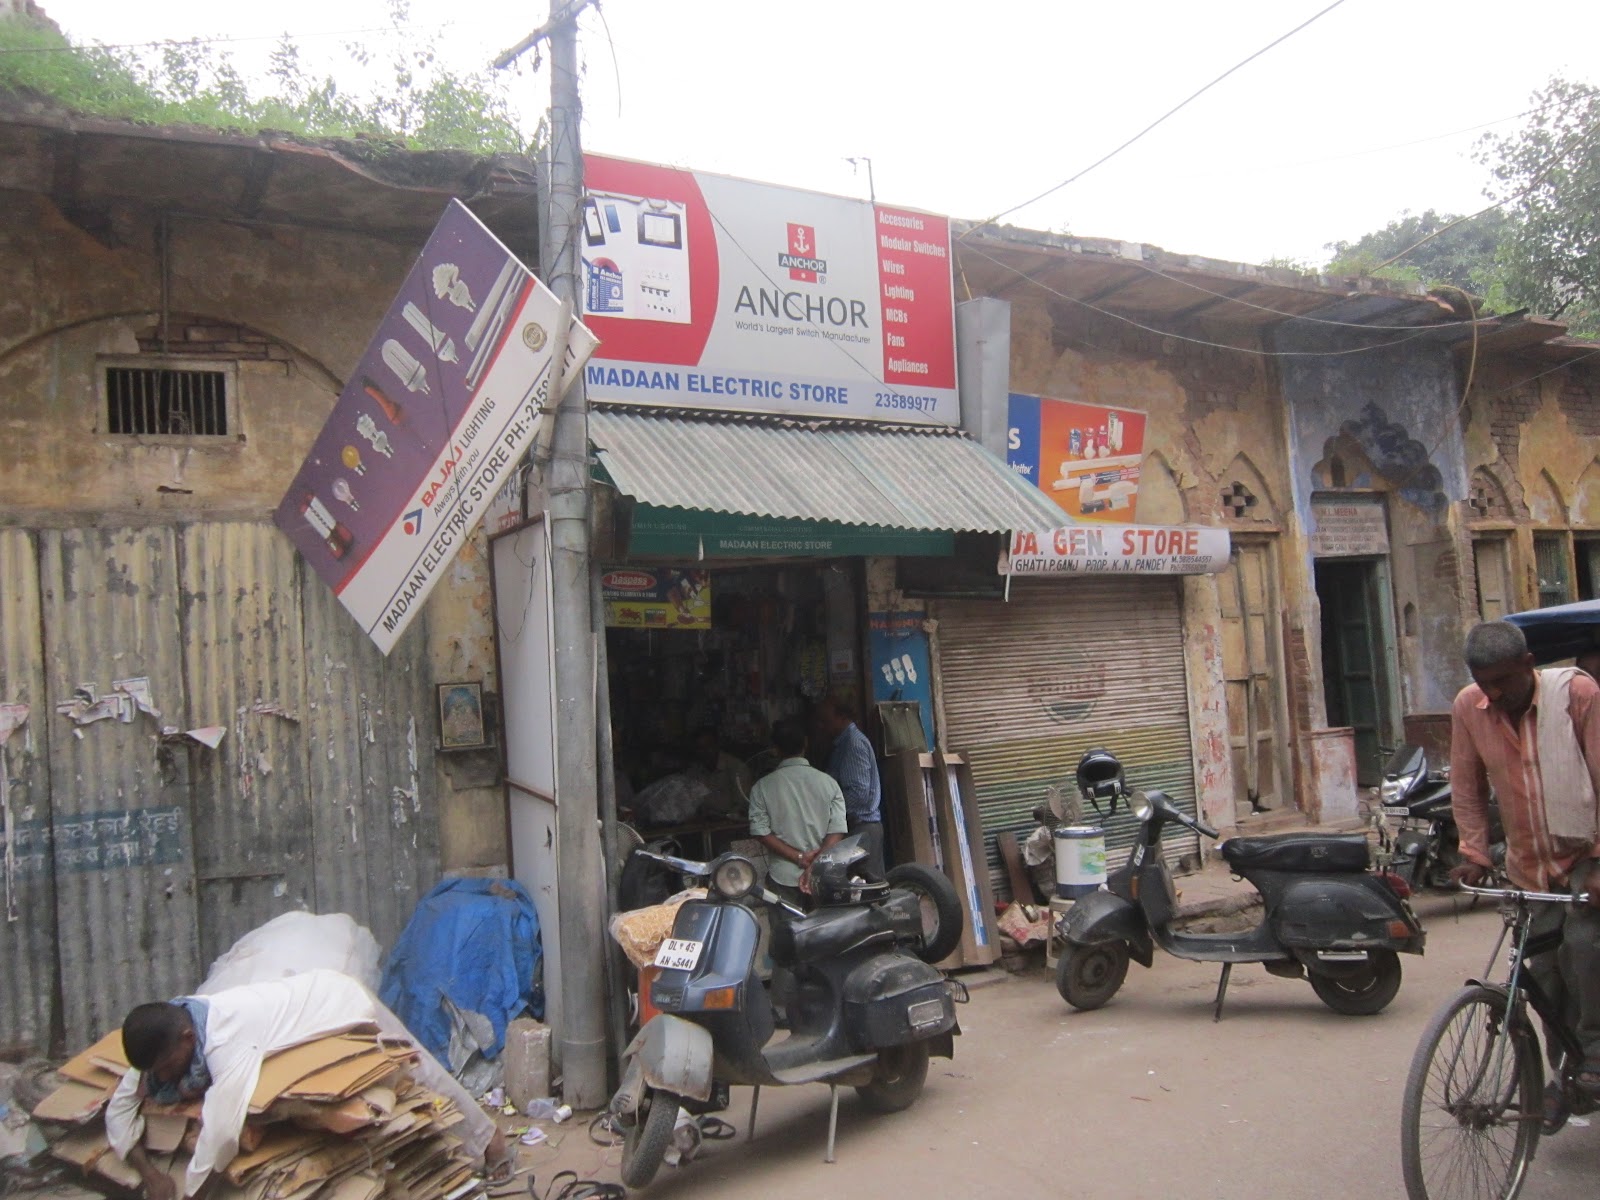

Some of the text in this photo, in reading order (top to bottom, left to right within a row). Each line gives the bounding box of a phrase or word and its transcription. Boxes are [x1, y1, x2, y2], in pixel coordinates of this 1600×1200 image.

[879, 211, 924, 230] Accessories
[881, 235, 945, 257] Modular Switches
[781, 255, 825, 272] ANCHOR
[882, 259, 905, 275] Wires
[884, 283, 915, 301] Lighting
[734, 285, 869, 328] ANCHOR
[886, 308, 908, 323] MCBs
[735, 321, 871, 344] World's Largest Switch Manufacturer
[887, 332, 905, 347] Fans
[888, 357, 928, 374] Appliances
[587, 366, 937, 411] MADAAN ELECTRIC STORE 23589977
[422, 397, 496, 506] BAJAJ LIGHTING
[433, 448, 481, 516] Always with you
[383, 569, 427, 634] MADAAN
[424, 499, 475, 574] ELECTRIC
[469, 450, 511, 503] STORE
[719, 539, 833, 551] MADAAN ELECTRIC STORE
[1053, 529, 1108, 556] GEN.
[1121, 528, 1199, 556] STORE
[1134, 557, 1168, 571] PANDEY
[668, 940, 696, 953] DL 4S
[660, 955, 694, 969] AN 5441
